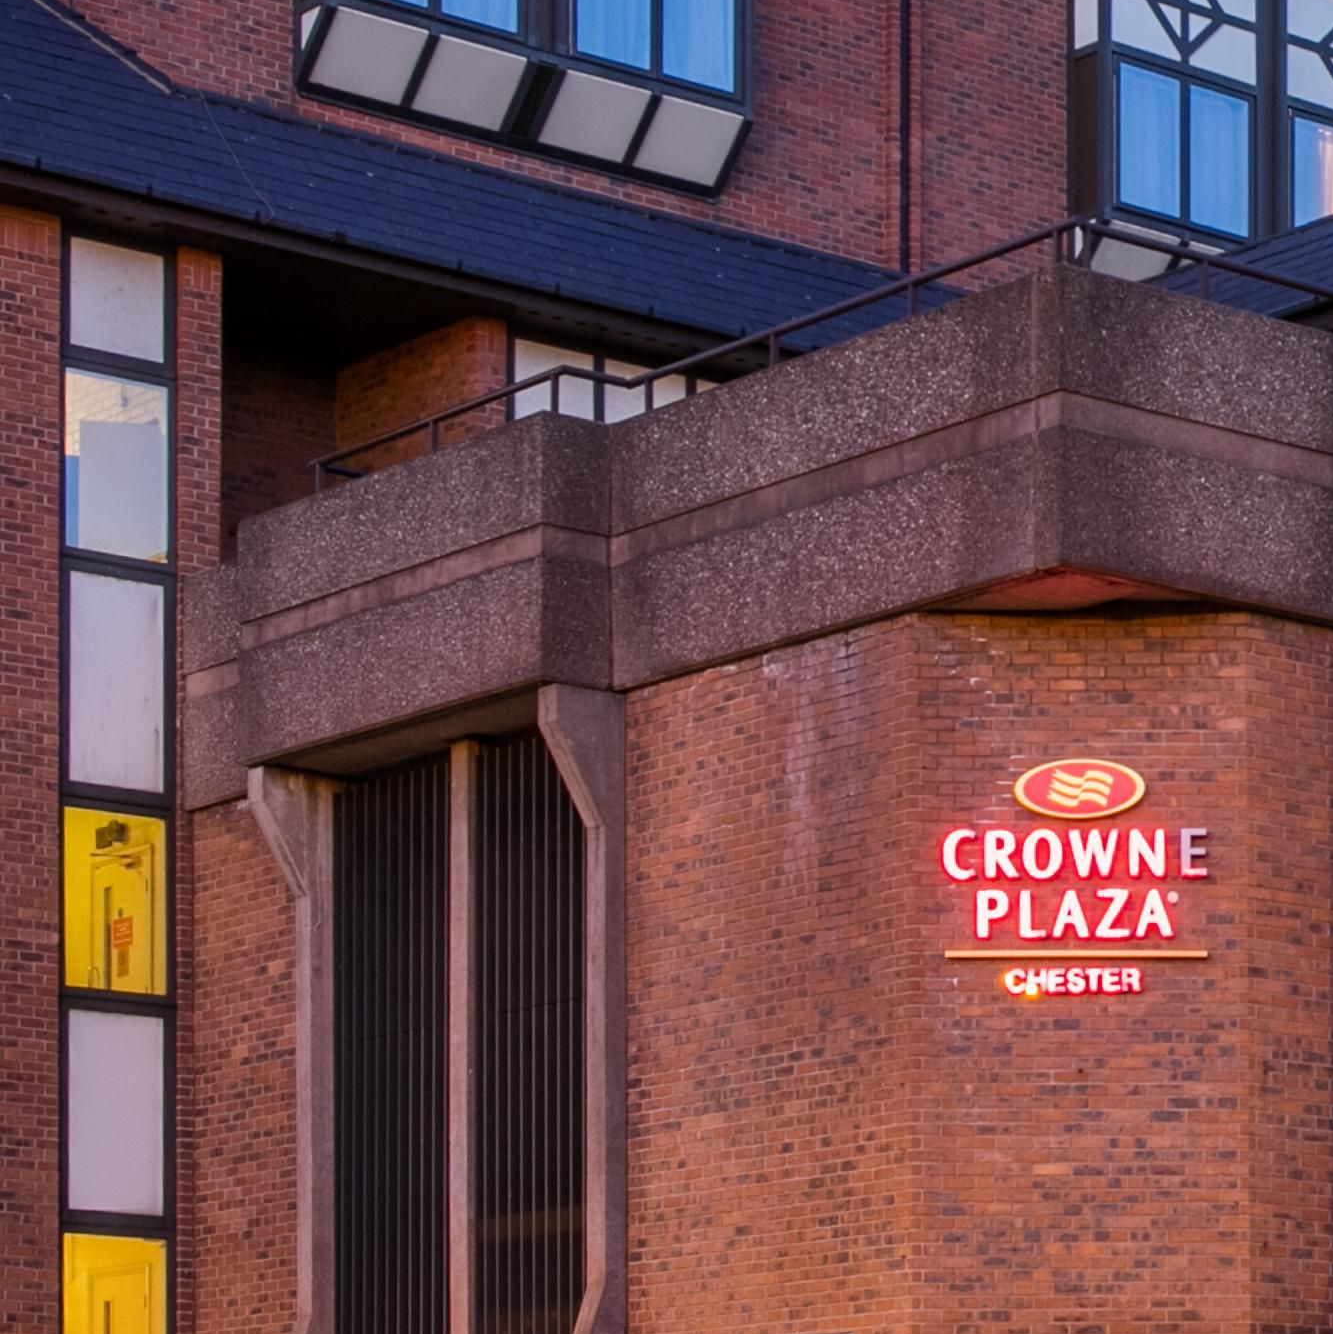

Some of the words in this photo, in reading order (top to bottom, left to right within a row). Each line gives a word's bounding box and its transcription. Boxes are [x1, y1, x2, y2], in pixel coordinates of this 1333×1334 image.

[942, 827, 1208, 881] CROWNE
[975, 888, 1175, 939] PLAZA
[1004, 967, 1142, 995] CHESTER
